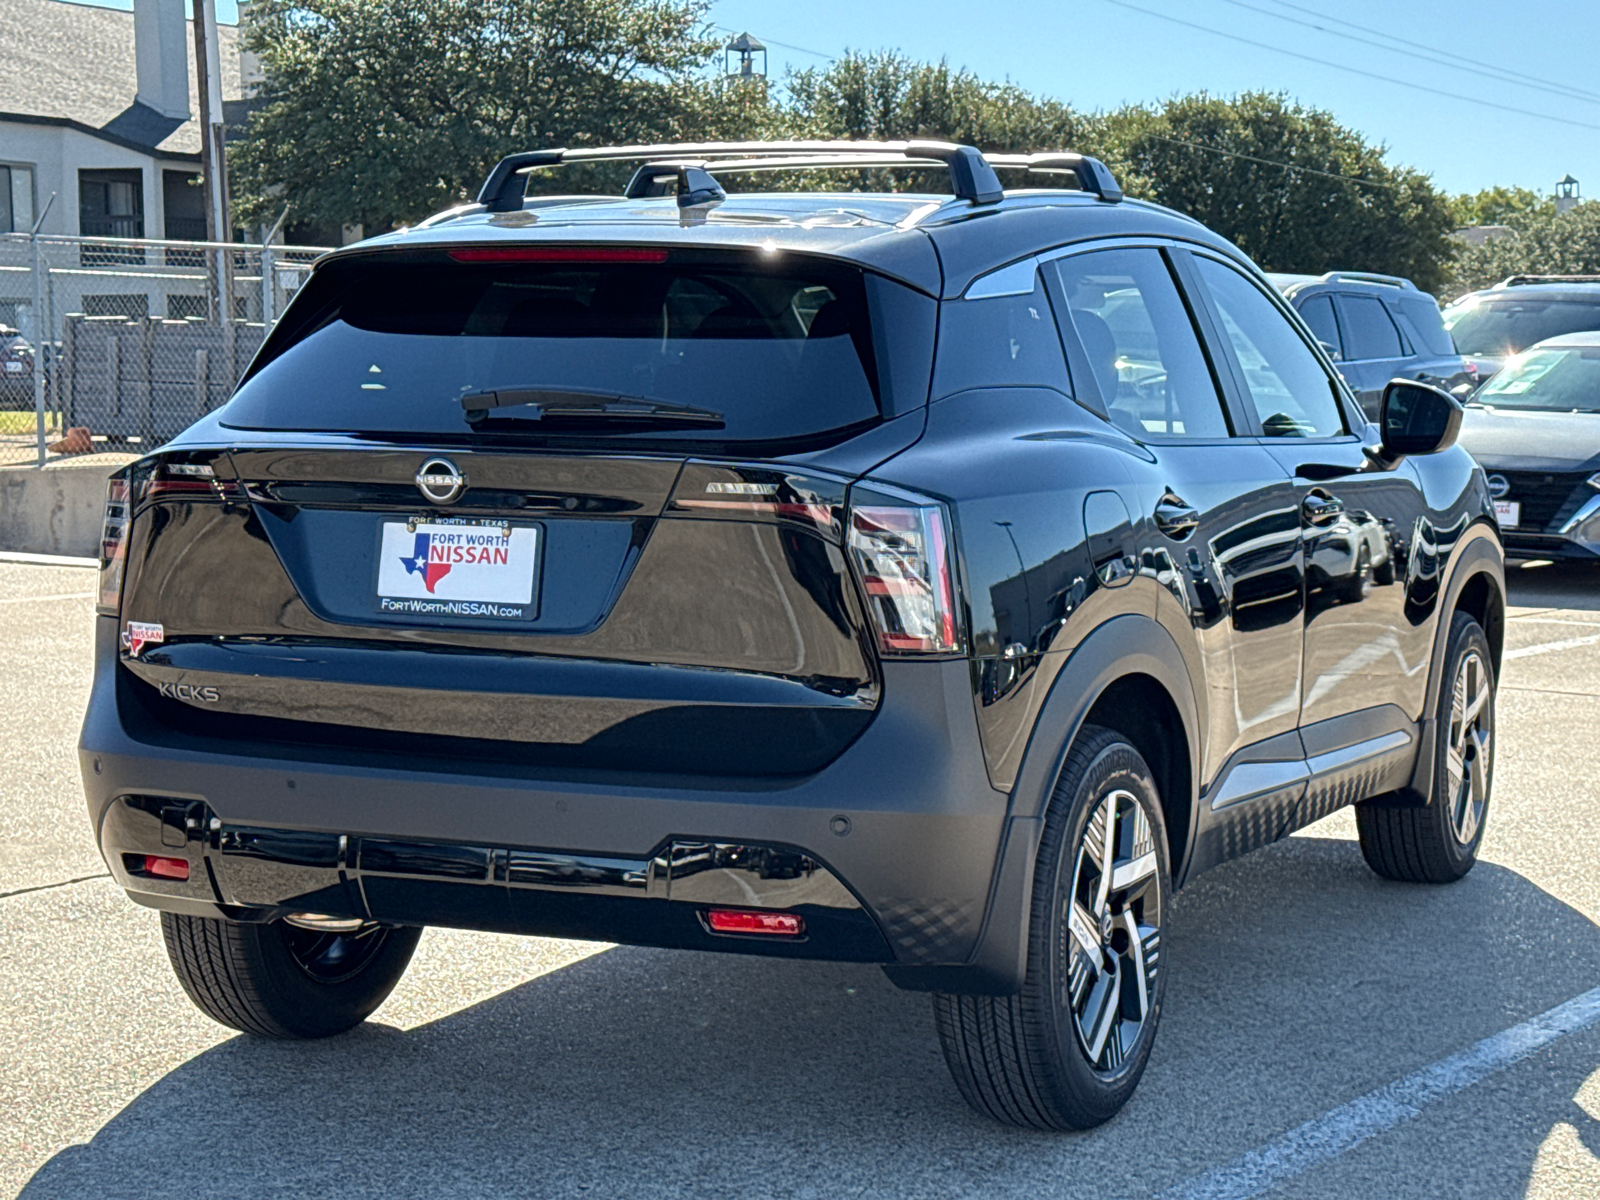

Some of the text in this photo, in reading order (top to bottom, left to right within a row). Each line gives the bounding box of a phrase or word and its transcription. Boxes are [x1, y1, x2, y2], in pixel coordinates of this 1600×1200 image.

[416, 475, 462, 485] NISSAN
[408, 516, 509, 528] FORT WORTH TEXAS
[431, 533, 509, 547] FORT WORTH
[430, 545, 509, 565] NISSAN
[133, 630, 162, 640] NISSAN
[159, 682, 219, 702] KICKS
